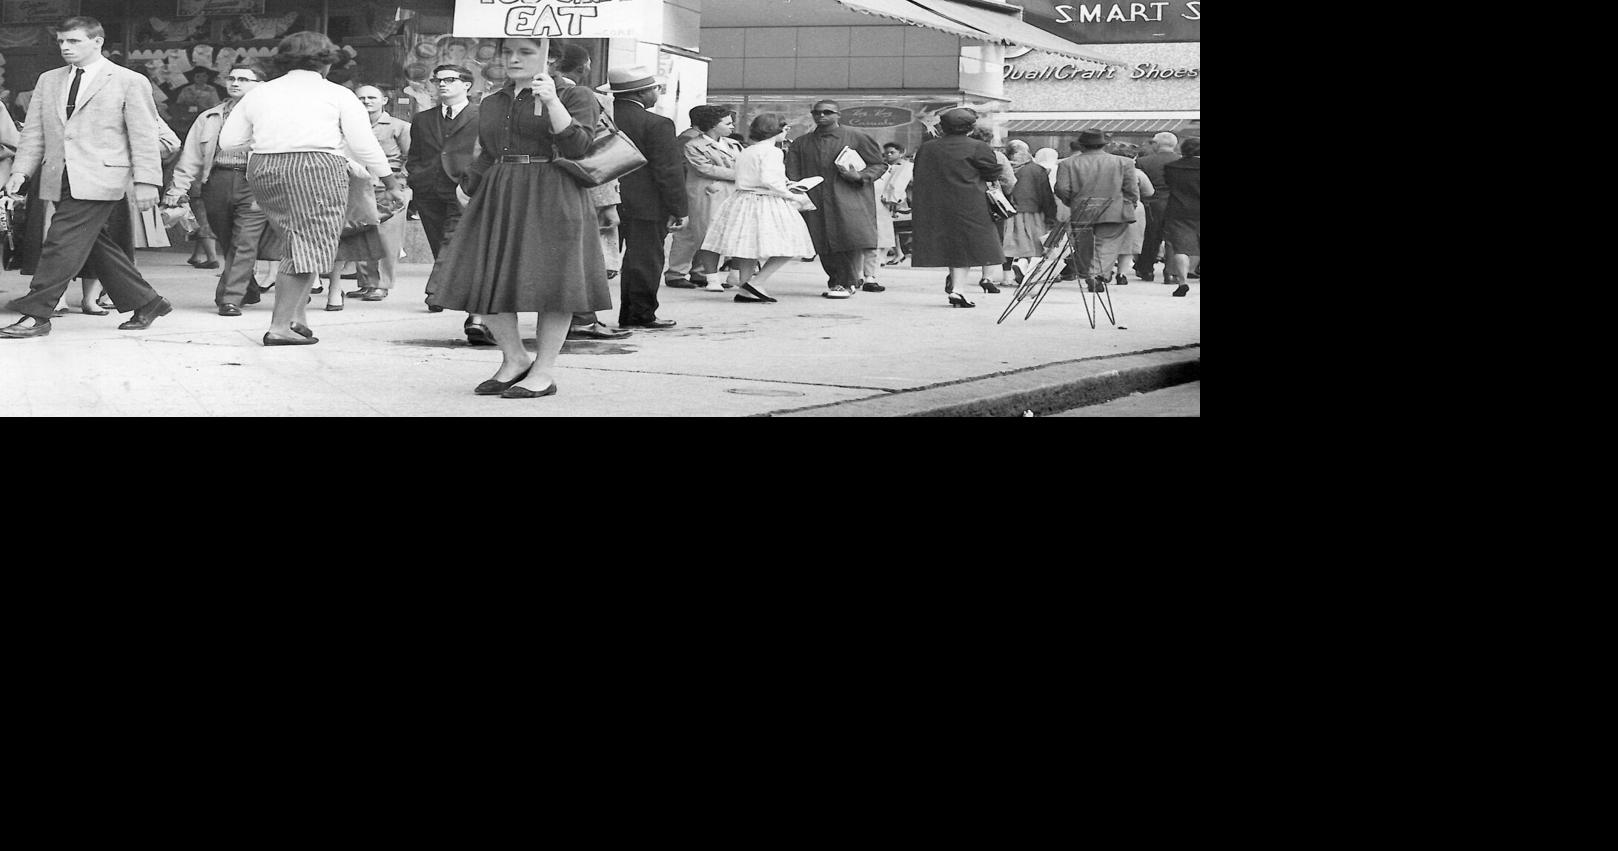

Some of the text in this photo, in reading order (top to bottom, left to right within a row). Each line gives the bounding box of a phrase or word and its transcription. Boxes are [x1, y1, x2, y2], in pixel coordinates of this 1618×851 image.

[505, 4, 598, 37] EAT
[1055, 2, 1169, 23] SMART
[1131, 63, 1199, 80] Shoes
